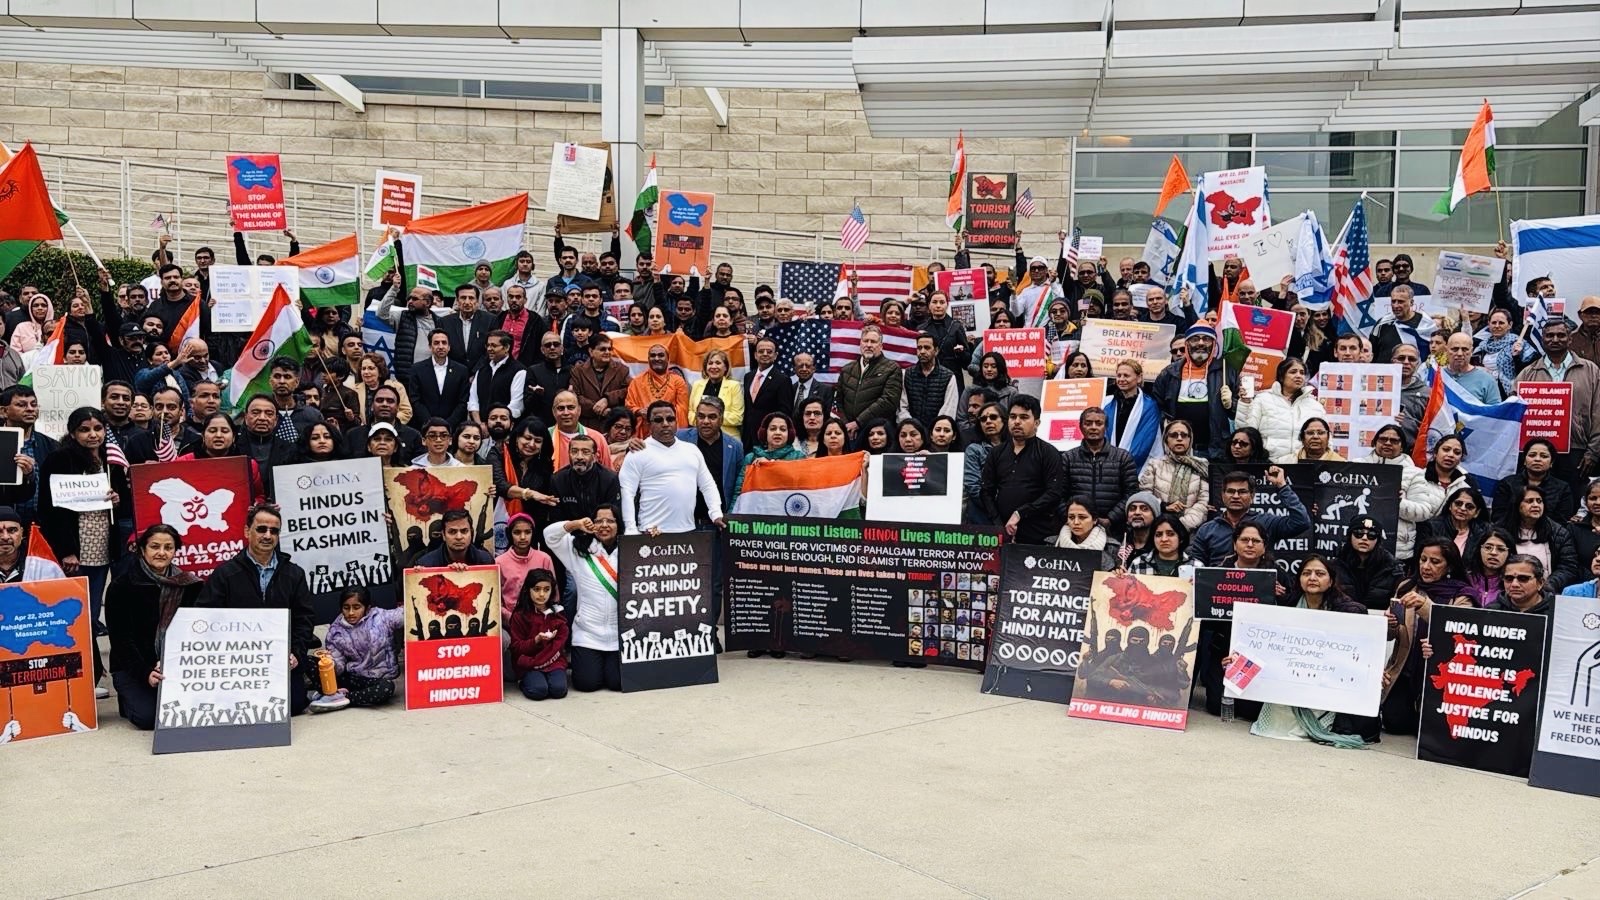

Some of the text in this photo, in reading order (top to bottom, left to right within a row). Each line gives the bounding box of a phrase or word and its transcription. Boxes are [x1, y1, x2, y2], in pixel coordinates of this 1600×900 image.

[970, 204, 1010, 214] TOURISM
[972, 220, 1010, 229] WITHOUT
[968, 234, 1017, 244] TERRORISM
[1254, 240, 1267, 256] I
[988, 331, 1041, 341] ALL EYES ON
[1103, 329, 1154, 340] BREAK THE
[992, 345, 1036, 354] PAHALGAM
[1107, 339, 1145, 347] SILENCE
[1101, 348, 1148, 359] STOP THE
[1023, 359, 1045, 367] INDIA
[37, 367, 99, 388] SAY NO
[50, 390, 79, 408] TO
[1526, 430, 1559, 438] KASHMIR.
[60, 480, 99, 489] HINDU
[313, 473, 361, 487] CoHNA
[1333, 473, 1378, 486] CoHNA
[300, 492, 364, 511] HINDUS
[288, 510, 379, 533] BELONG IN
[293, 530, 377, 552] KASHMIR.
[728, 521, 1003, 547] The World must Listen: HINDU Lives Matter too!
[175, 540, 243, 556] HALGAM
[652, 544, 695, 557] CoHNA
[729, 539, 994, 561] PRAYER VIGIL FOR VICTIMS OF PAHALGAM TERROR ATTACK
[1274, 538, 1309, 551] ATE!
[194, 554, 212, 564] 22,
[216, 551, 239, 561] 202
[740, 550, 983, 571] ENOUGH IS ENOUGH, END ISLAMIST TERRORISM NOW
[635, 563, 698, 577] STAND UP
[772, 564, 783, 572] not
[784, 565, 797, 574] just
[845, 569, 857, 577] are
[897, 571, 906, 580] by
[1037, 558, 1082, 572] CoHNA
[631, 578, 701, 594] FOR HINDU
[1031, 575, 1070, 591] ZERO
[1217, 584, 1253, 592] CODDLING
[1009, 589, 1091, 610] TOLERANCE
[625, 595, 707, 620] SAFETY.
[14, 614, 27, 622] Apr
[1012, 606, 1082, 626] FOR ANTI-
[1, 623, 32, 632] Pahalgam
[50, 619, 68, 627] India,
[210, 622, 264, 633] CoHNA
[1001, 621, 1046, 638] HINDU
[1445, 621, 1527, 641] INDIA UNDER
[15, 630, 47, 638] Massacre
[1247, 627, 1276, 640] STOP
[1283, 632, 1315, 646] HINDU
[181, 640, 274, 652] HOW MANY
[437, 645, 470, 659] STOP
[1249, 640, 1324, 659] NO MORE ISLAMIC
[1454, 643, 1514, 660] ATTACK!
[28, 658, 48, 670] STOP
[179, 654, 273, 666] MORE MUST
[1286, 658, 1336, 673] TERRORISM
[12, 667, 67, 684] TERRORISM
[182, 667, 269, 679] DIE BEFORE
[418, 665, 491, 681] MURDERING
[1448, 662, 1517, 682] SILENCE IS
[180, 680, 270, 692] YOU CARE?
[1448, 683, 1513, 703] VIOLENCE.
[429, 687, 480, 702] HINDUS!
[1069, 701, 1183, 723] STOP KILLING HINDUS
[1437, 702, 1519, 725] JUSTICE FOR
[1553, 710, 1570, 721] WE
[1452, 724, 1499, 743] HINDUS
[1571, 723, 1591, 734] THE
